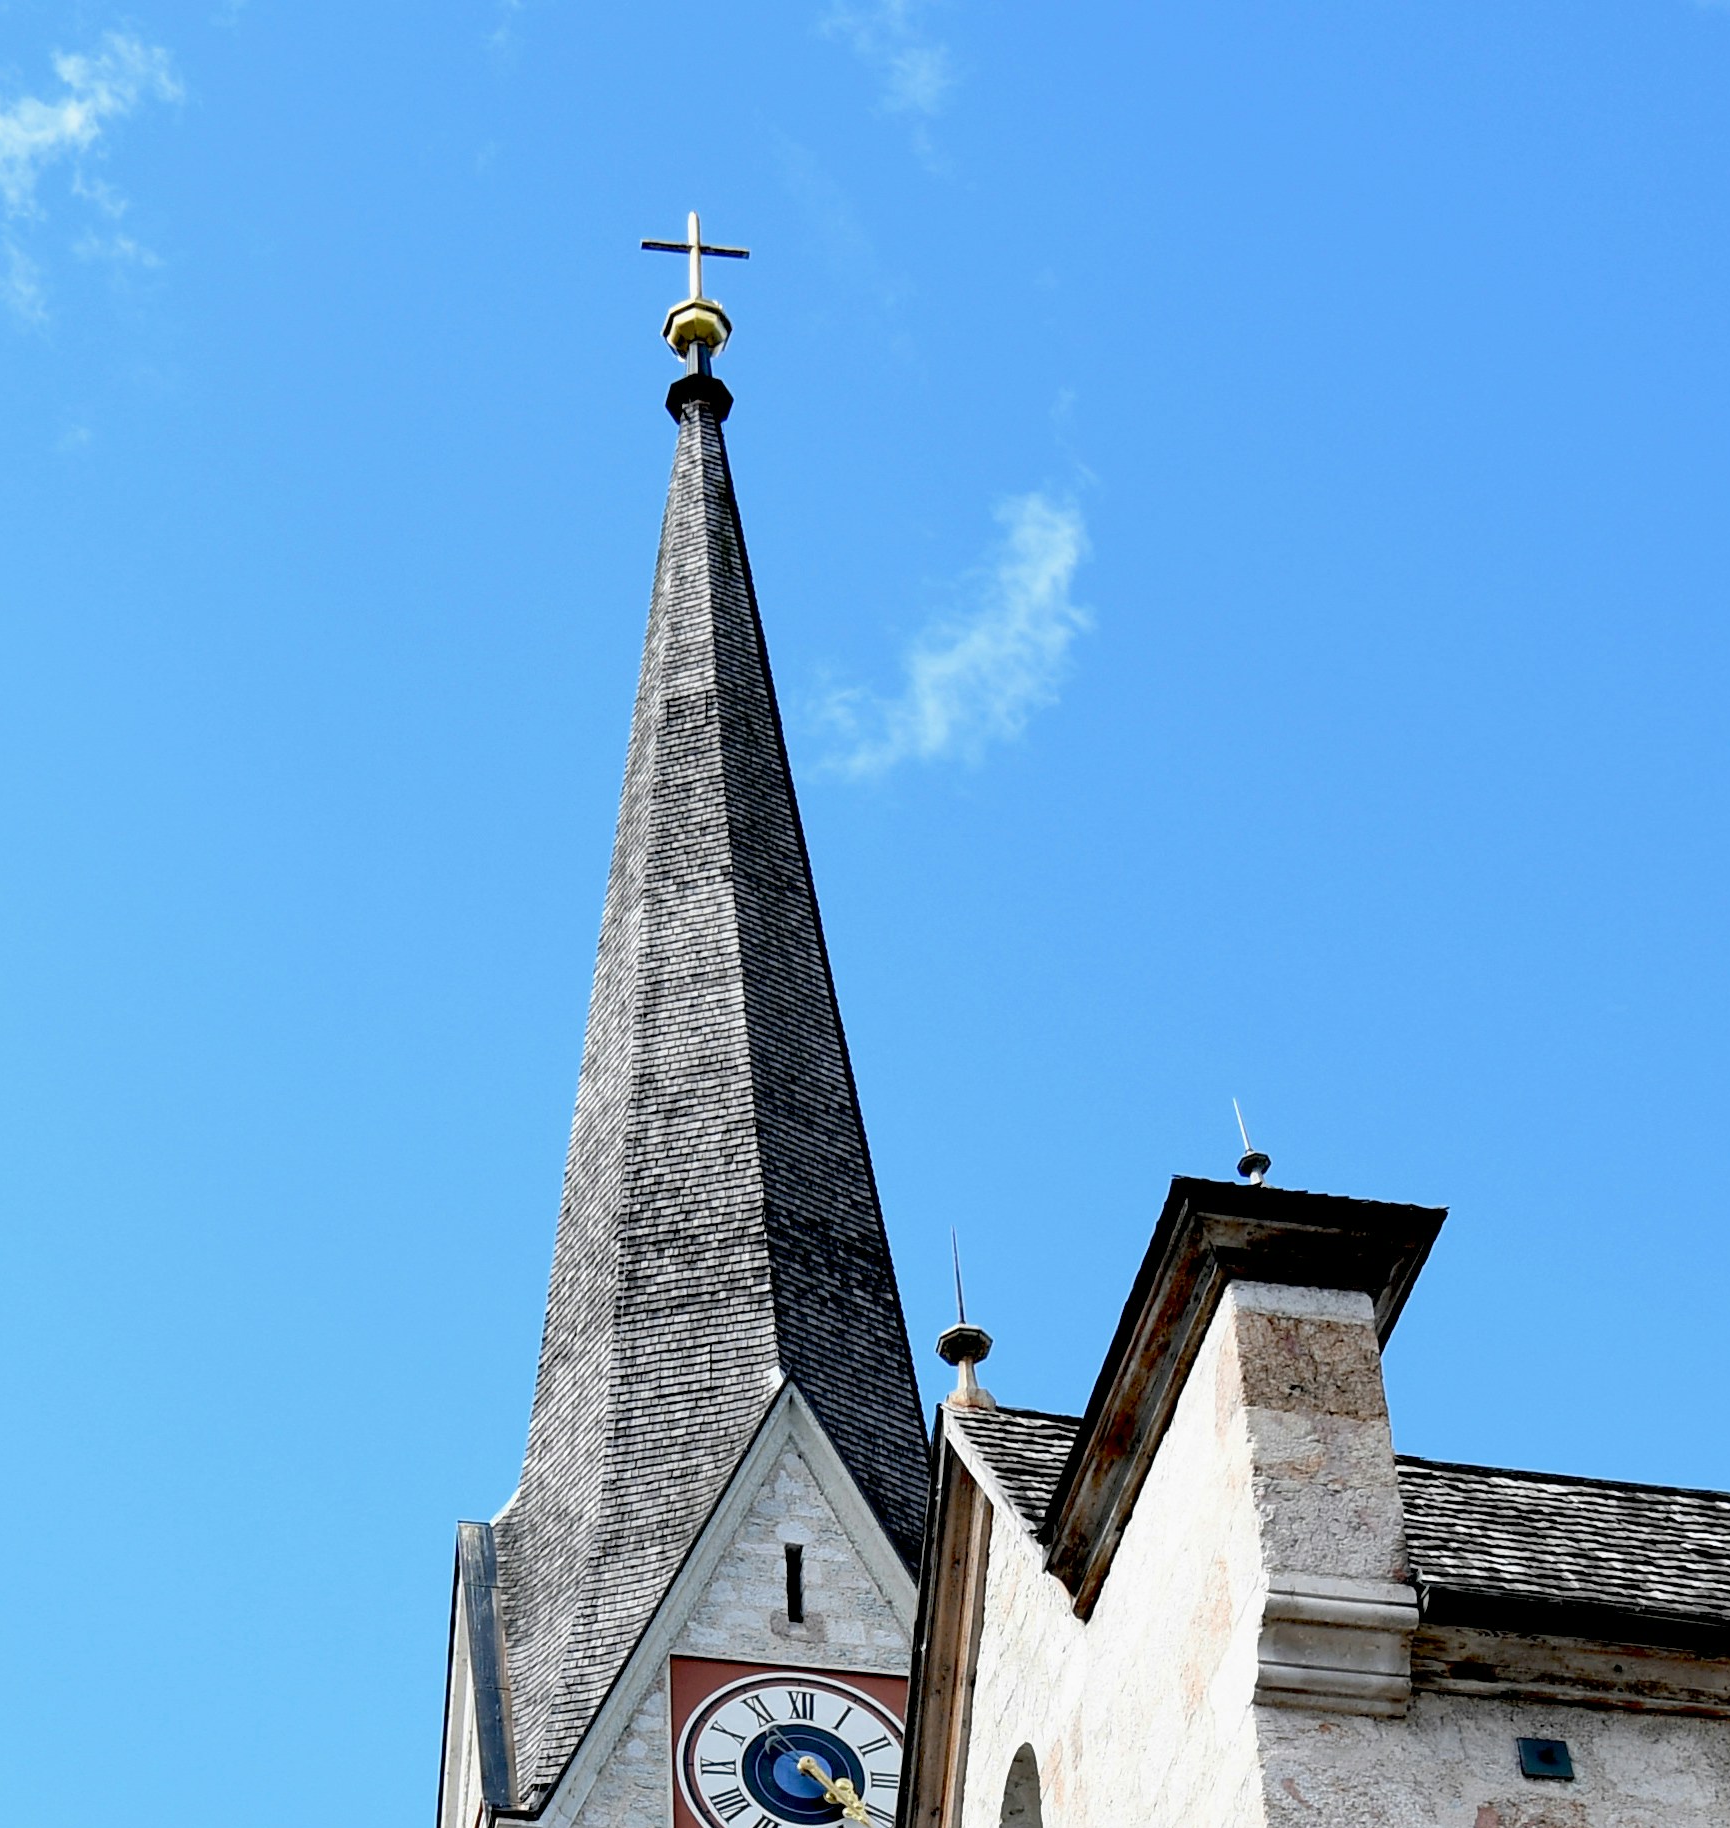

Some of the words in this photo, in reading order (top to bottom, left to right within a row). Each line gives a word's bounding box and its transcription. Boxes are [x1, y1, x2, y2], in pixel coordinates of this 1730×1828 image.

[740, 1694, 778, 1728] XI
[786, 1691, 816, 1721] XII
[832, 1705, 854, 1732] I
[710, 1720, 747, 1747] X
[857, 1734, 893, 1757] II
[700, 1756, 738, 1777] IX
[870, 1770, 900, 1789] III
[708, 1785, 753, 1824] VIII
